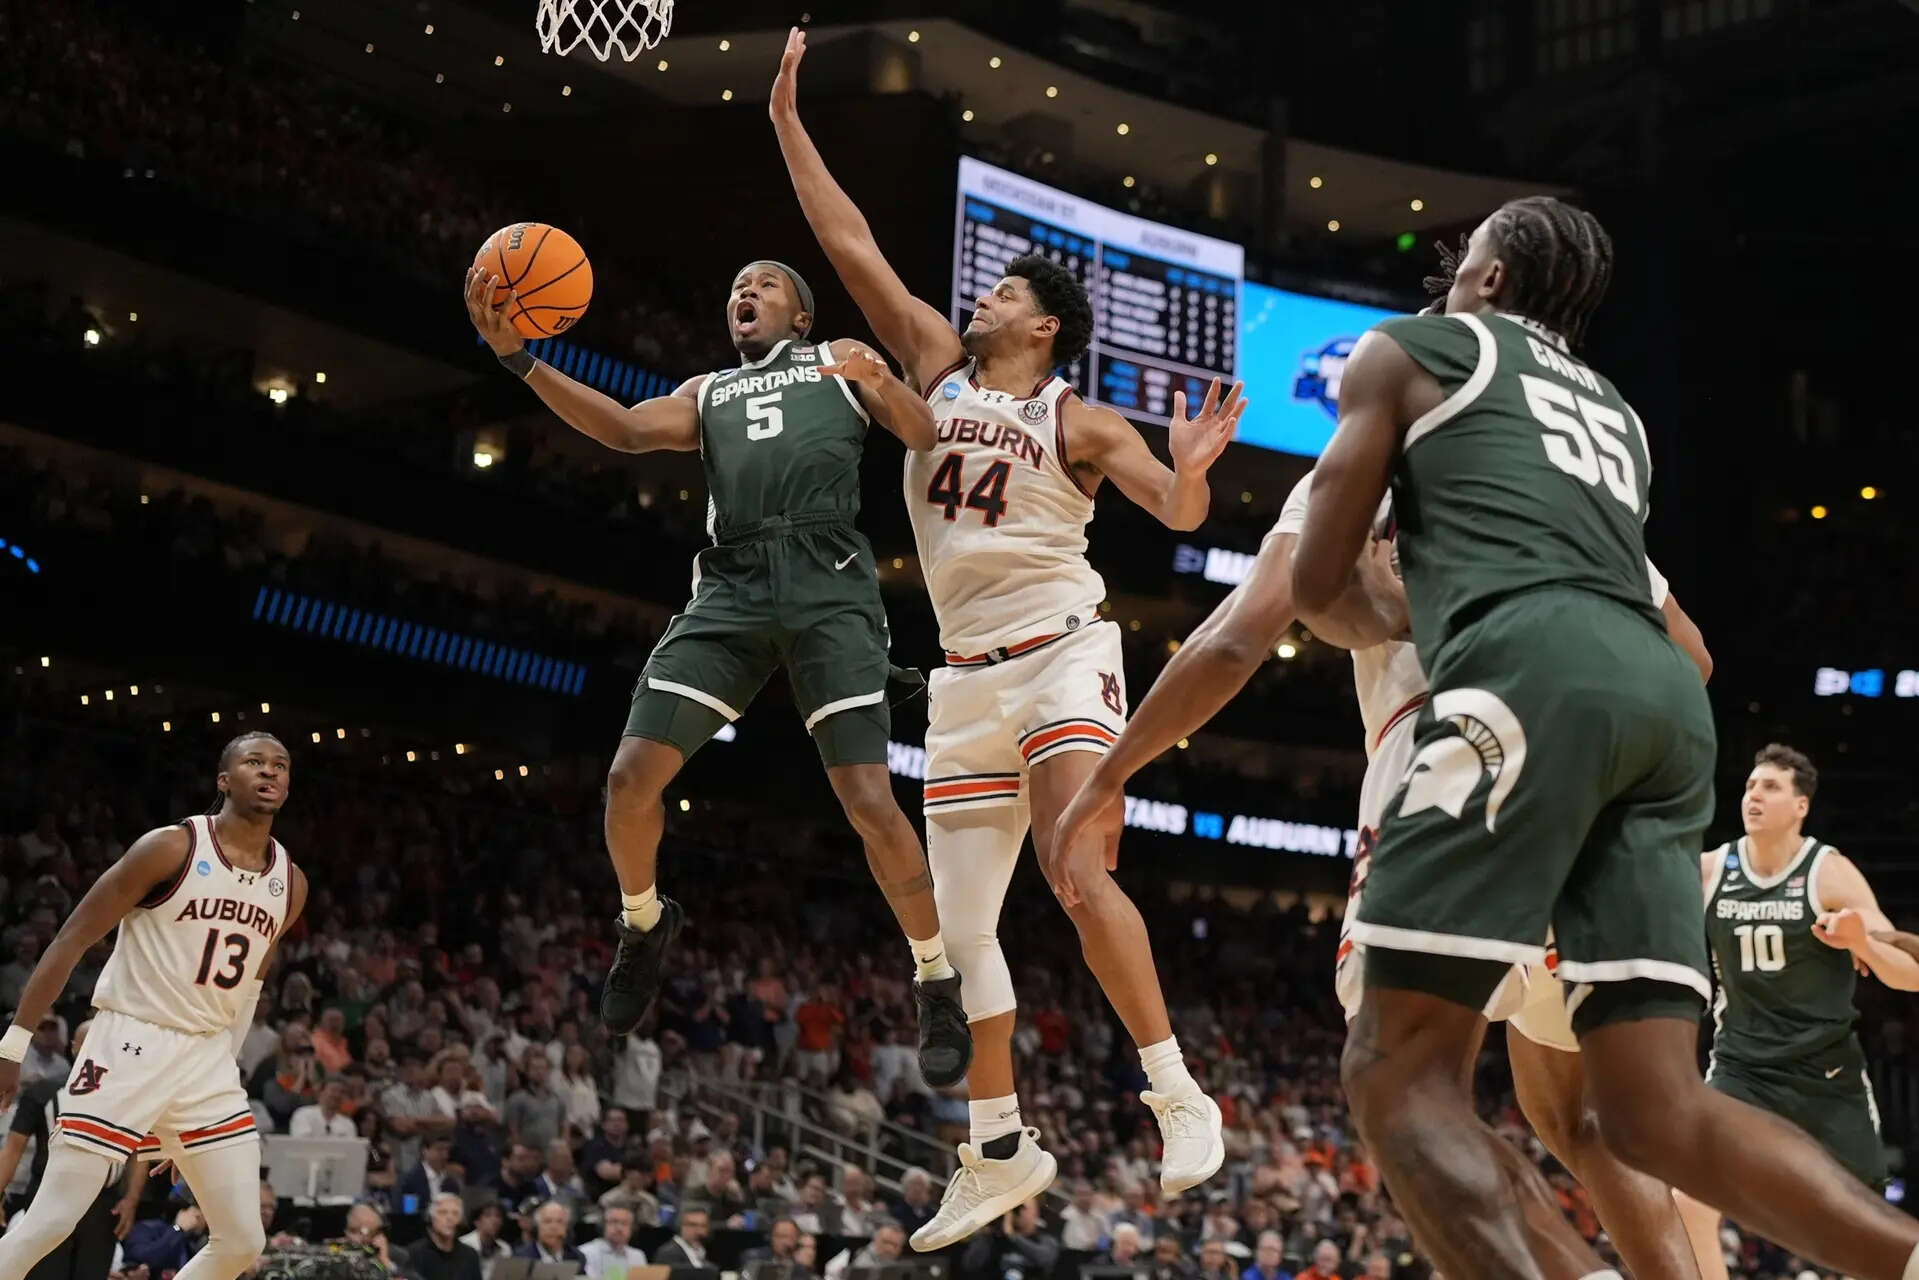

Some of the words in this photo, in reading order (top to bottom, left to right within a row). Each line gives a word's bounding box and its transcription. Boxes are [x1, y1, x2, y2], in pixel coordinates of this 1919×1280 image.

[711, 365, 822, 408] SPARTANS
[746, 392, 784, 441] 5
[936, 417, 1044, 471] UBURN
[1519, 373, 1640, 515] 55
[927, 452, 1012, 528] 44
[1226, 814, 1341, 857] AUBURN
[174, 897, 279, 945] AUBURN
[1716, 898, 1804, 920] SPARTANS
[194, 927, 251, 990] 13
[1733, 925, 1786, 972] 10
